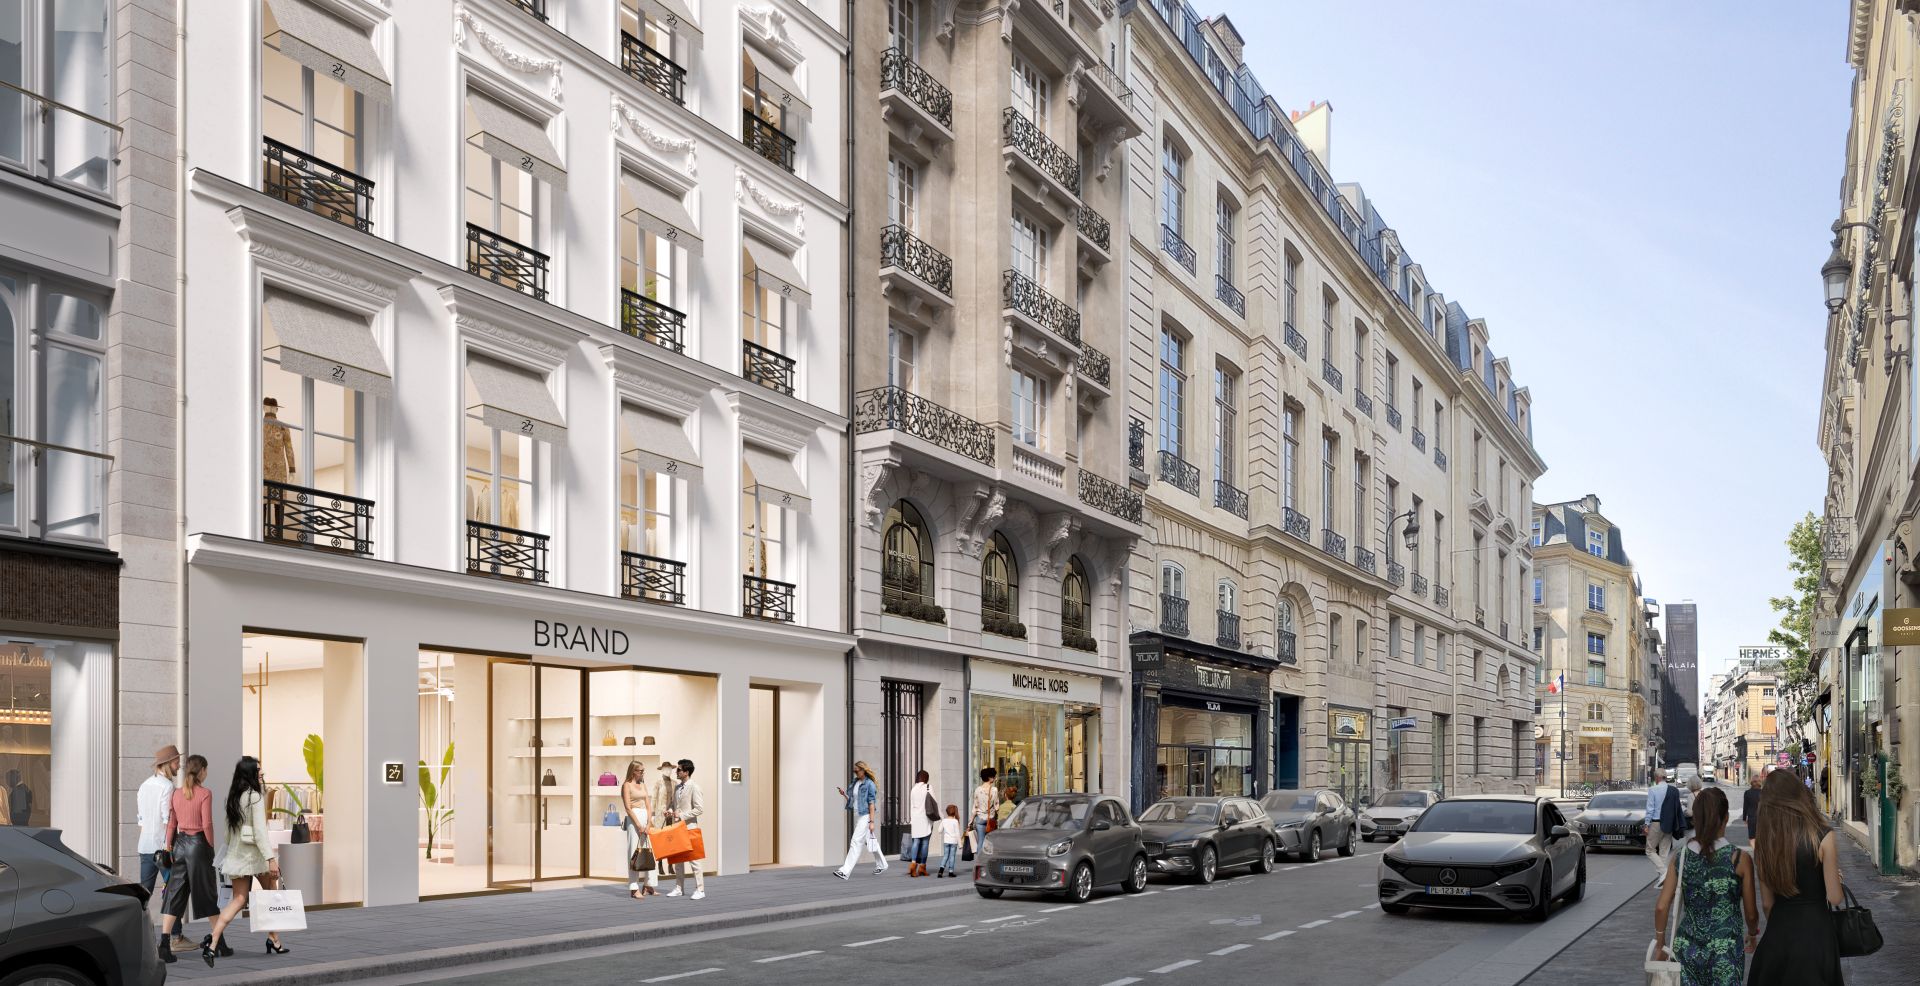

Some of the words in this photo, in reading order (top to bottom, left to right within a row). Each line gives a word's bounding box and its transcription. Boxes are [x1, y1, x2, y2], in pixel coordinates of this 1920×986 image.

[534, 619, 630, 655] BRAND
[1739, 647, 1780, 659] HERMÈS
[1012, 673, 1047, 691] MICHAEL
[1048, 679, 1069, 694] KORS
